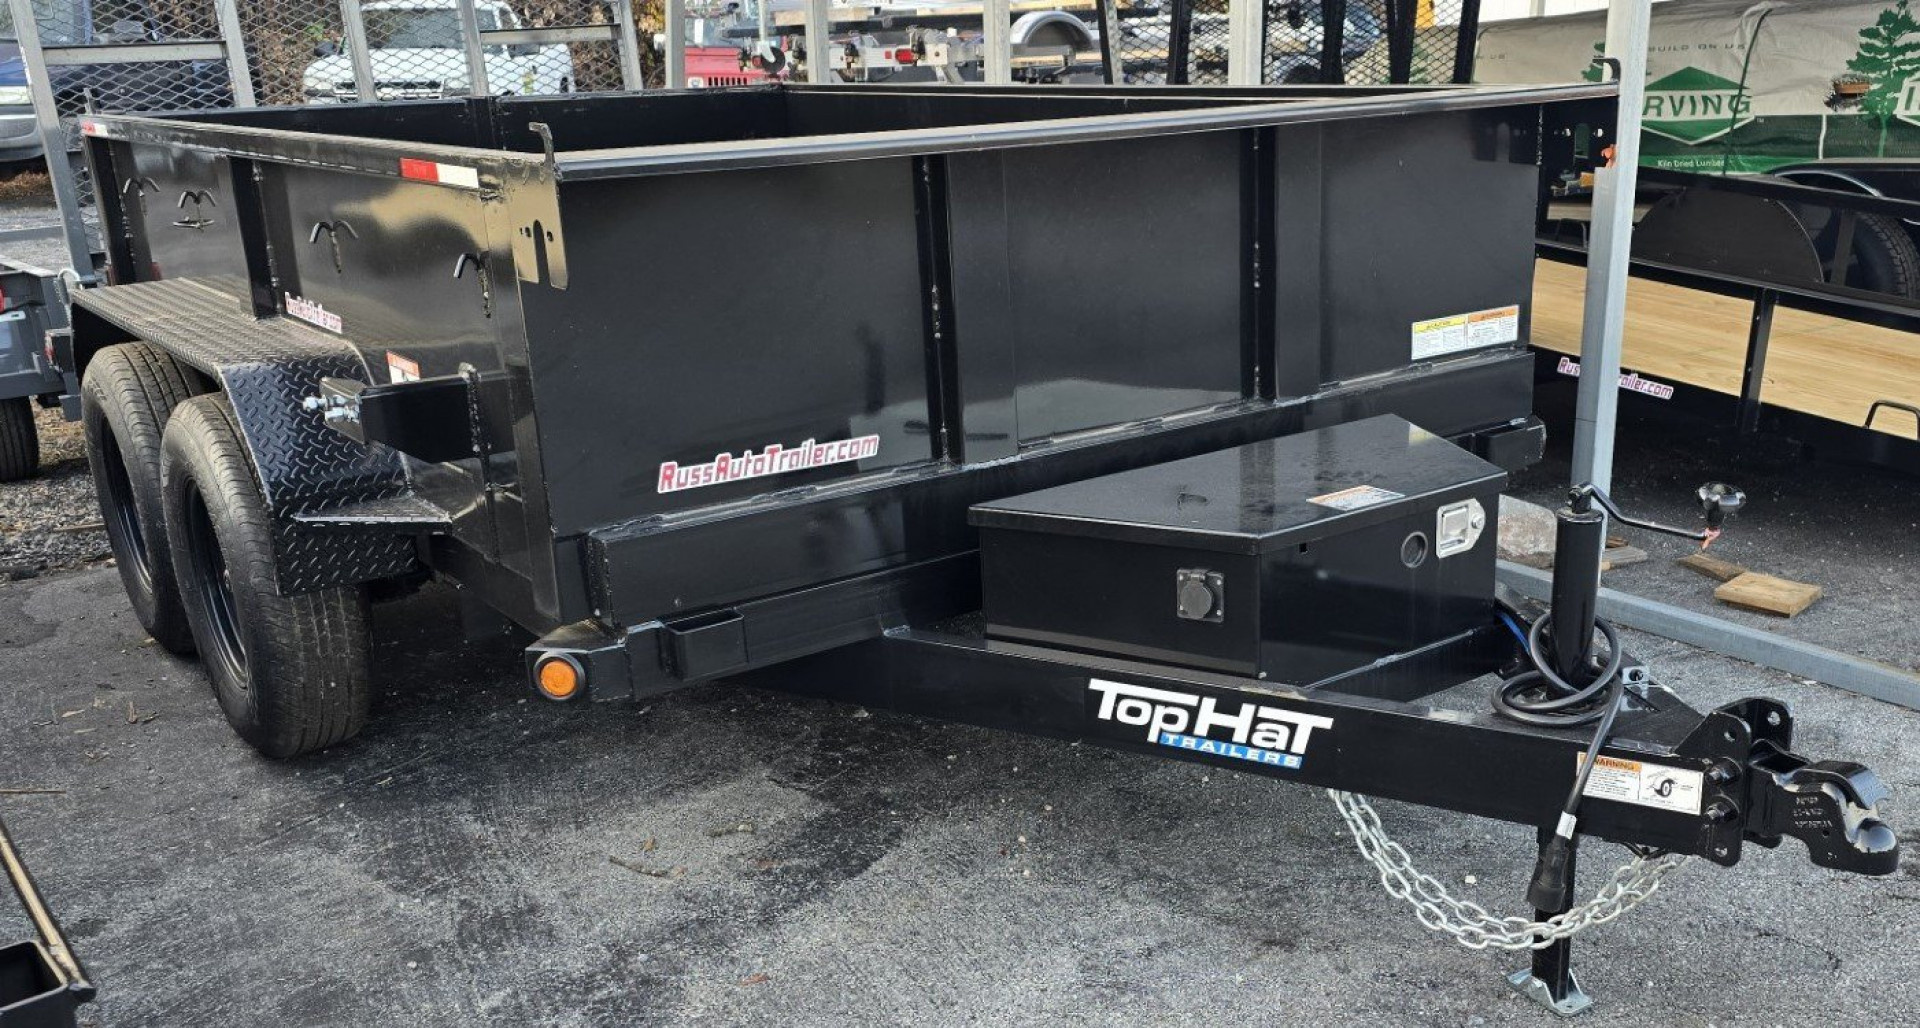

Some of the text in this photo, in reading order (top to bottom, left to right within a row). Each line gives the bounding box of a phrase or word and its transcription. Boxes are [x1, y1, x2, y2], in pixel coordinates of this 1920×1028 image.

[1642, 94, 1753, 117] RVING
[658, 435, 879, 493] RussAutoTrailer.com
[1165, 732, 1302, 768] TRAILERS
